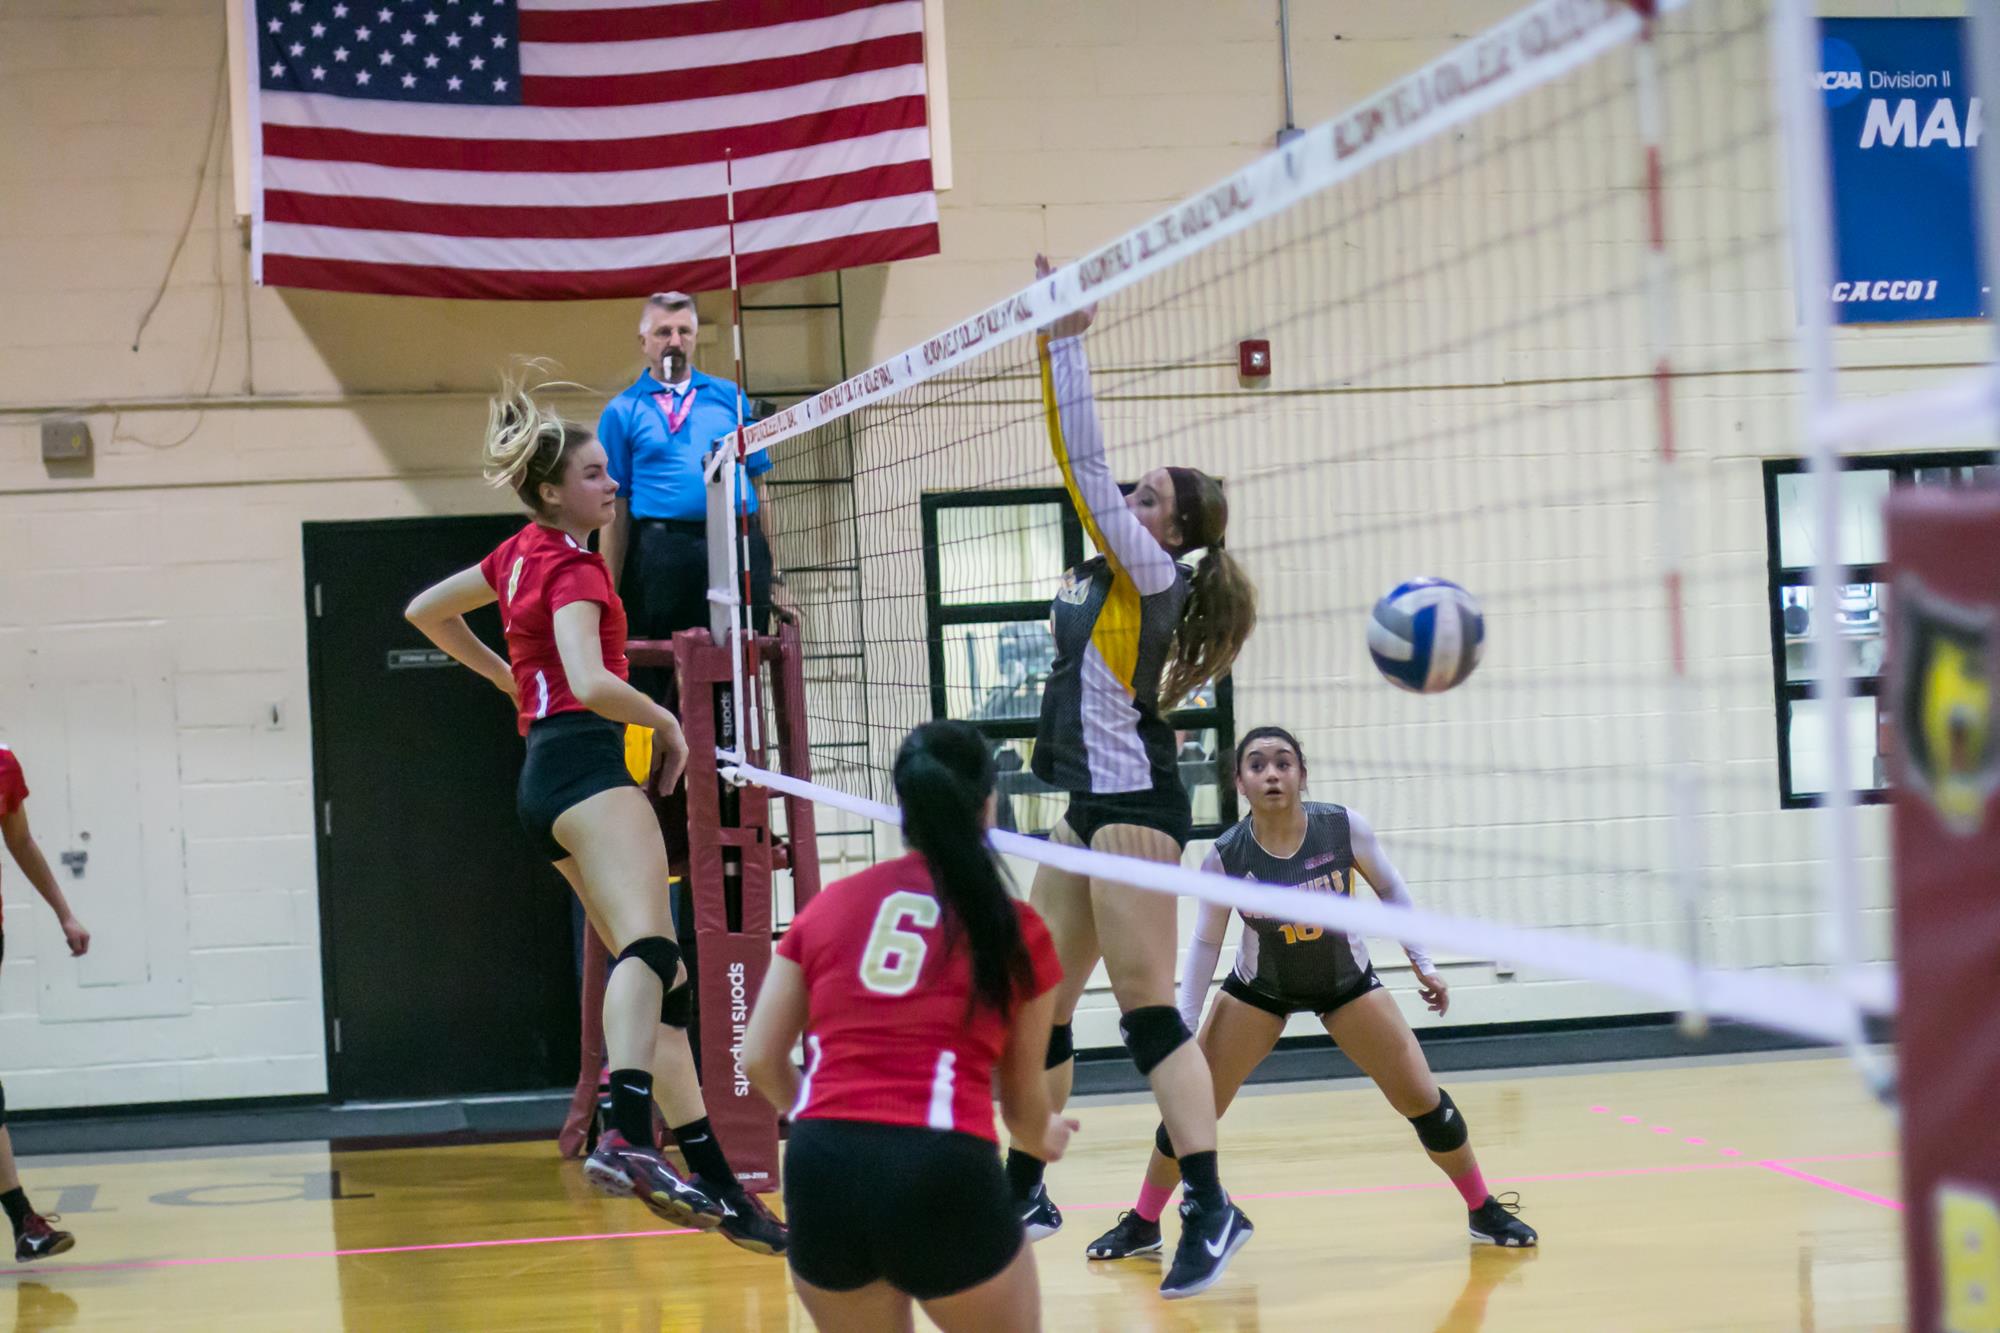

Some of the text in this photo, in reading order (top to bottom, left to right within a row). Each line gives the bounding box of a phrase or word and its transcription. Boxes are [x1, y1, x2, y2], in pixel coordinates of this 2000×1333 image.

[1869, 71, 1938, 89] Division
[1942, 70, 1951, 88] II
[860, 890, 940, 996] 6
[727, 962, 751, 1097] sports imports
